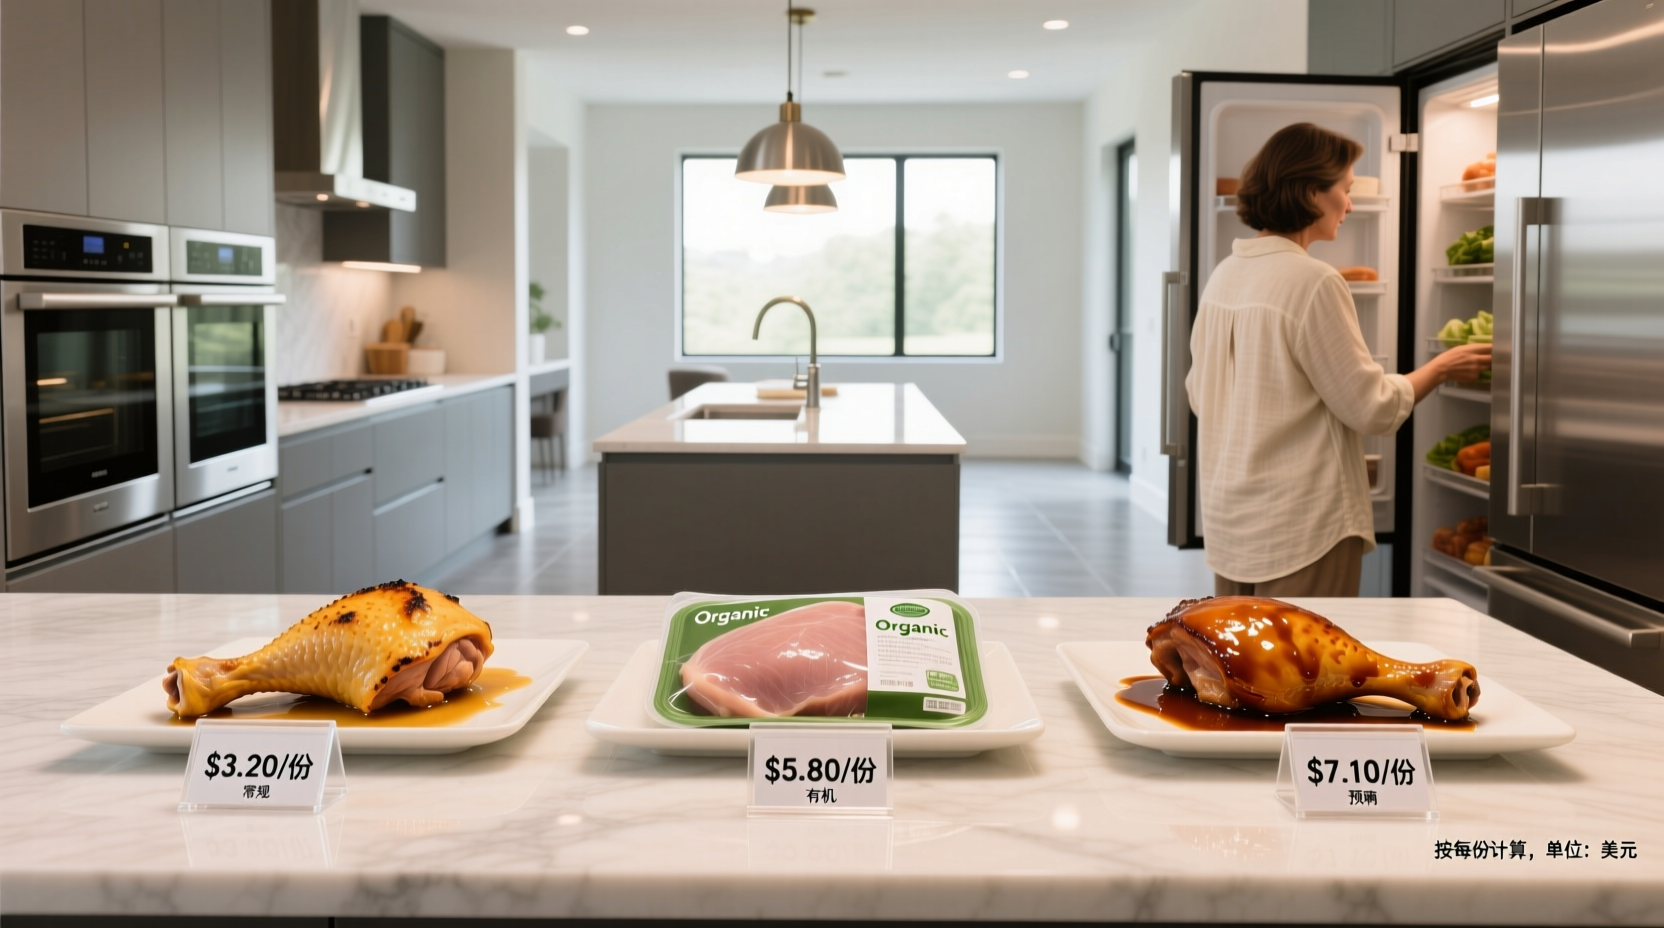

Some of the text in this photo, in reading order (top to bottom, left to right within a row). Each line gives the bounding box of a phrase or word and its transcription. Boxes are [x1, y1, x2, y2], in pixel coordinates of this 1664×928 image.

[694, 606, 770, 626] Organic
[875, 619, 949, 638] Organic
[204, 750, 314, 780] $3.20/份
[765, 755, 877, 785] $5.80/份
[1307, 756, 1416, 787] $7.10/份
[806, 788, 838, 804] 有机
